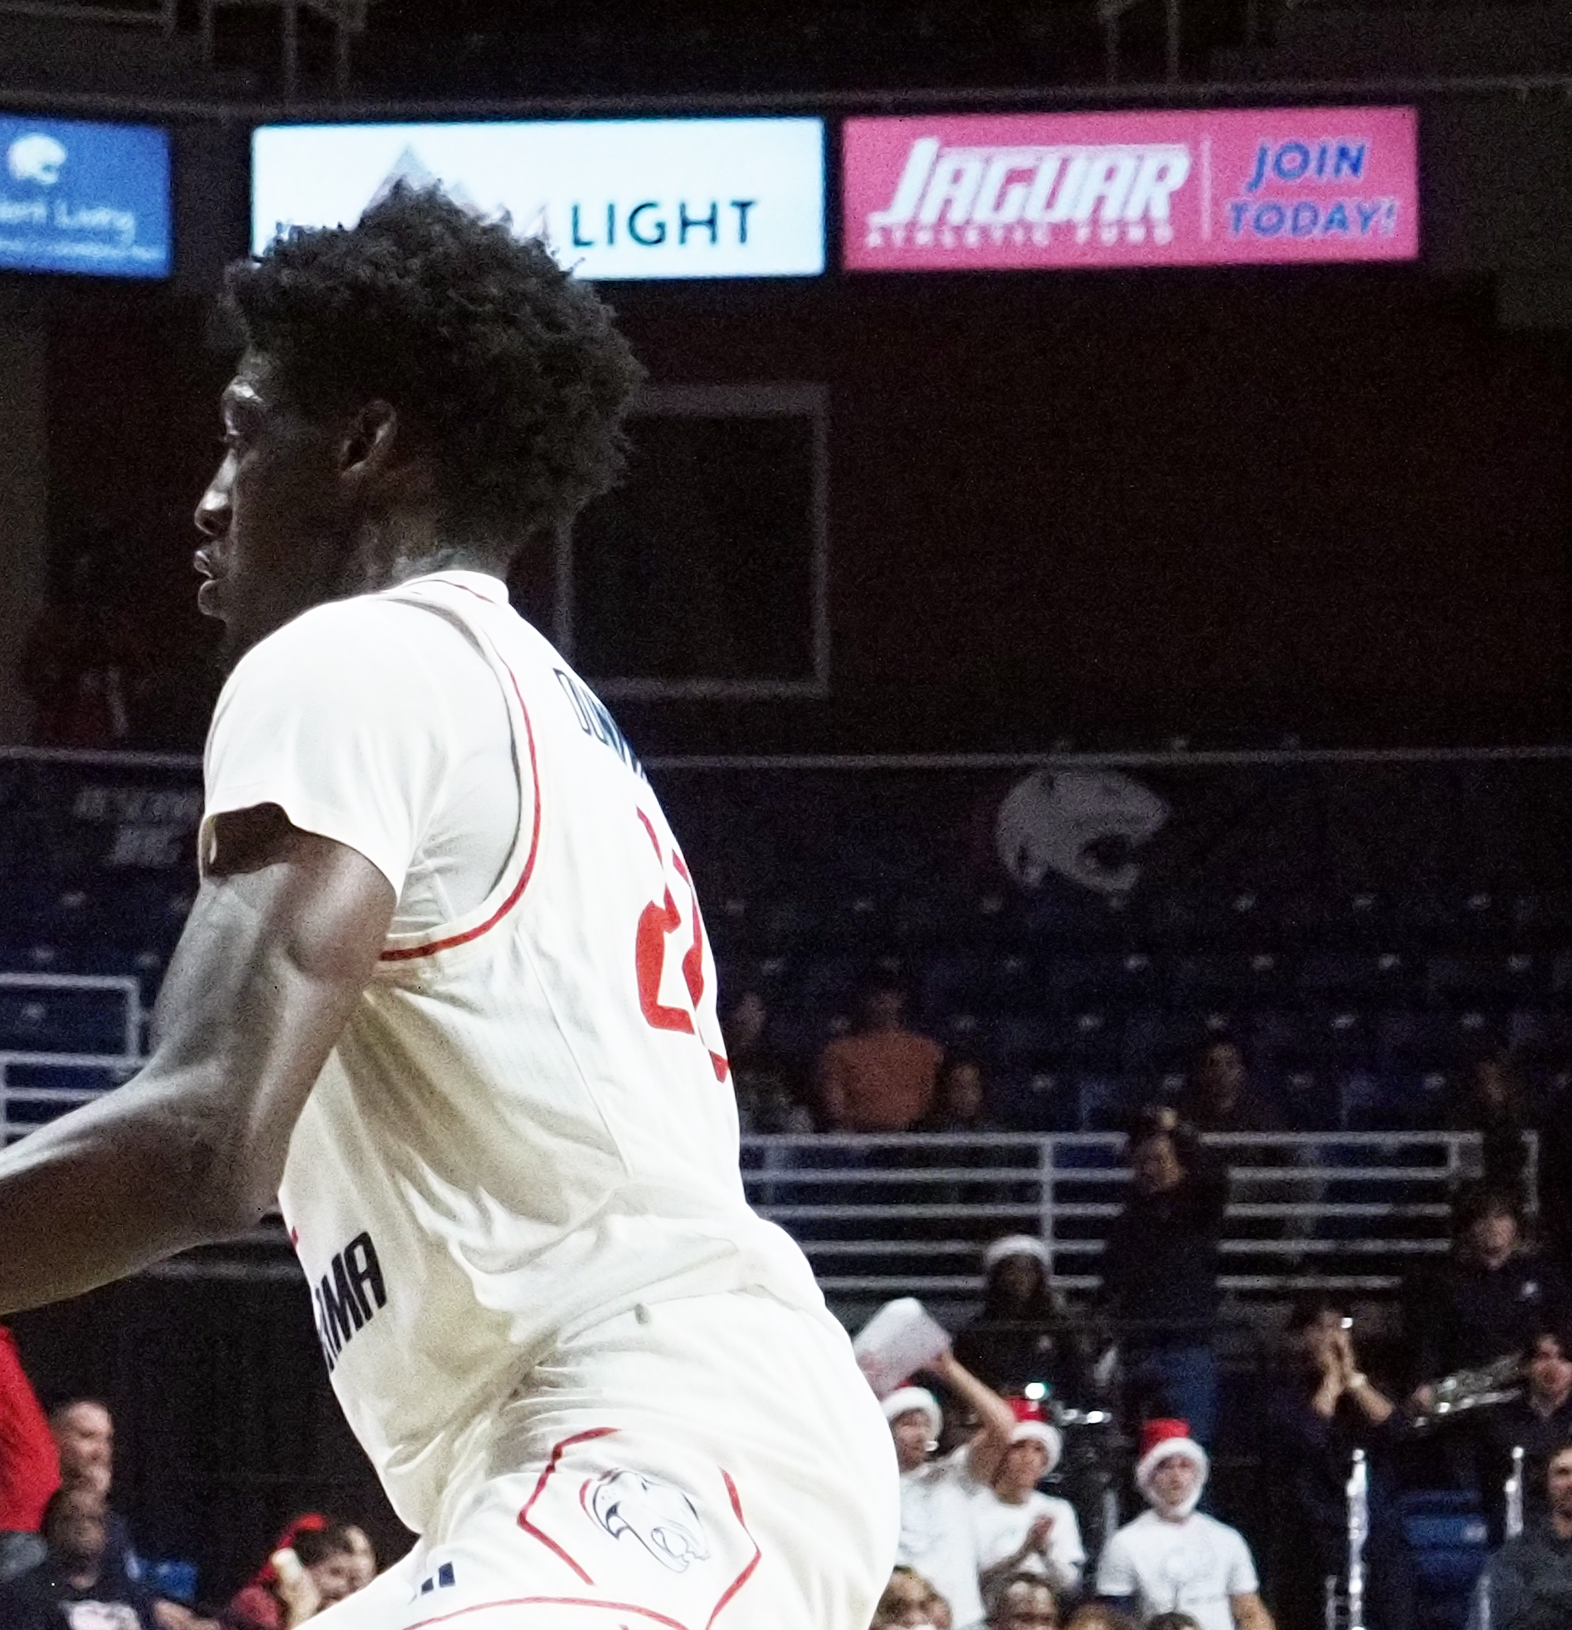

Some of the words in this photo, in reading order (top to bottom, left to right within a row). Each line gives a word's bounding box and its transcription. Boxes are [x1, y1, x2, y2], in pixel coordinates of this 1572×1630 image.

[868, 135, 1191, 226] JAGUAR
[1243, 141, 1368, 193] JOIN
[570, 199, 759, 248] LIGHT
[1229, 200, 1397, 236] TODAY!
